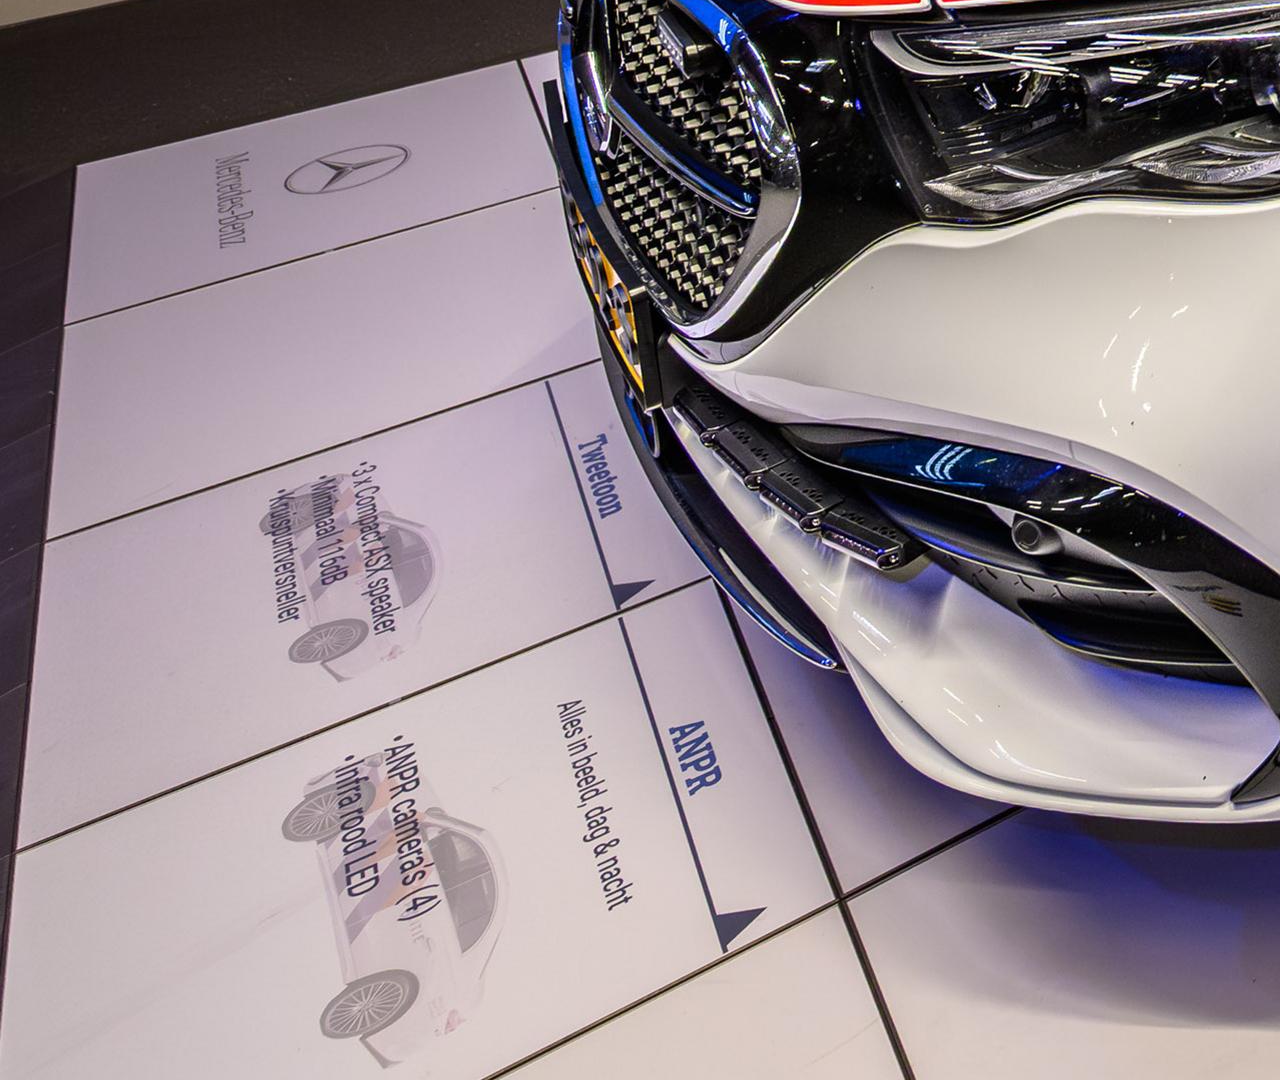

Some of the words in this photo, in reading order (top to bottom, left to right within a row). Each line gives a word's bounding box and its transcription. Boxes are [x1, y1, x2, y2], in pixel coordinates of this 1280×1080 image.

[215, 151, 254, 249] Mercedes-Benz
[352, 465, 377, 477] 3
[353, 476, 373, 489] x
[578, 433, 622, 519] Tweetoon
[310, 477, 345, 541] Minimaal
[351, 485, 387, 547] Compact
[264, 491, 307, 624] Kruispuntversneller
[317, 538, 349, 586] 116dB
[363, 545, 393, 579] ASX
[361, 577, 402, 636] speaker
[557, 699, 587, 739] Alles
[384, 742, 420, 800] ANPR
[567, 735, 593, 757] in
[668, 720, 722, 797] ANPR
[335, 759, 370, 809] Infra
[571, 751, 608, 809] beeld,
[340, 807, 377, 856] rood
[392, 798, 435, 886] camera's
[583, 806, 613, 843] dag
[593, 838, 620, 858] &
[344, 851, 380, 898] LED
[597, 855, 633, 911] nacht
[395, 884, 442, 921] (4)
